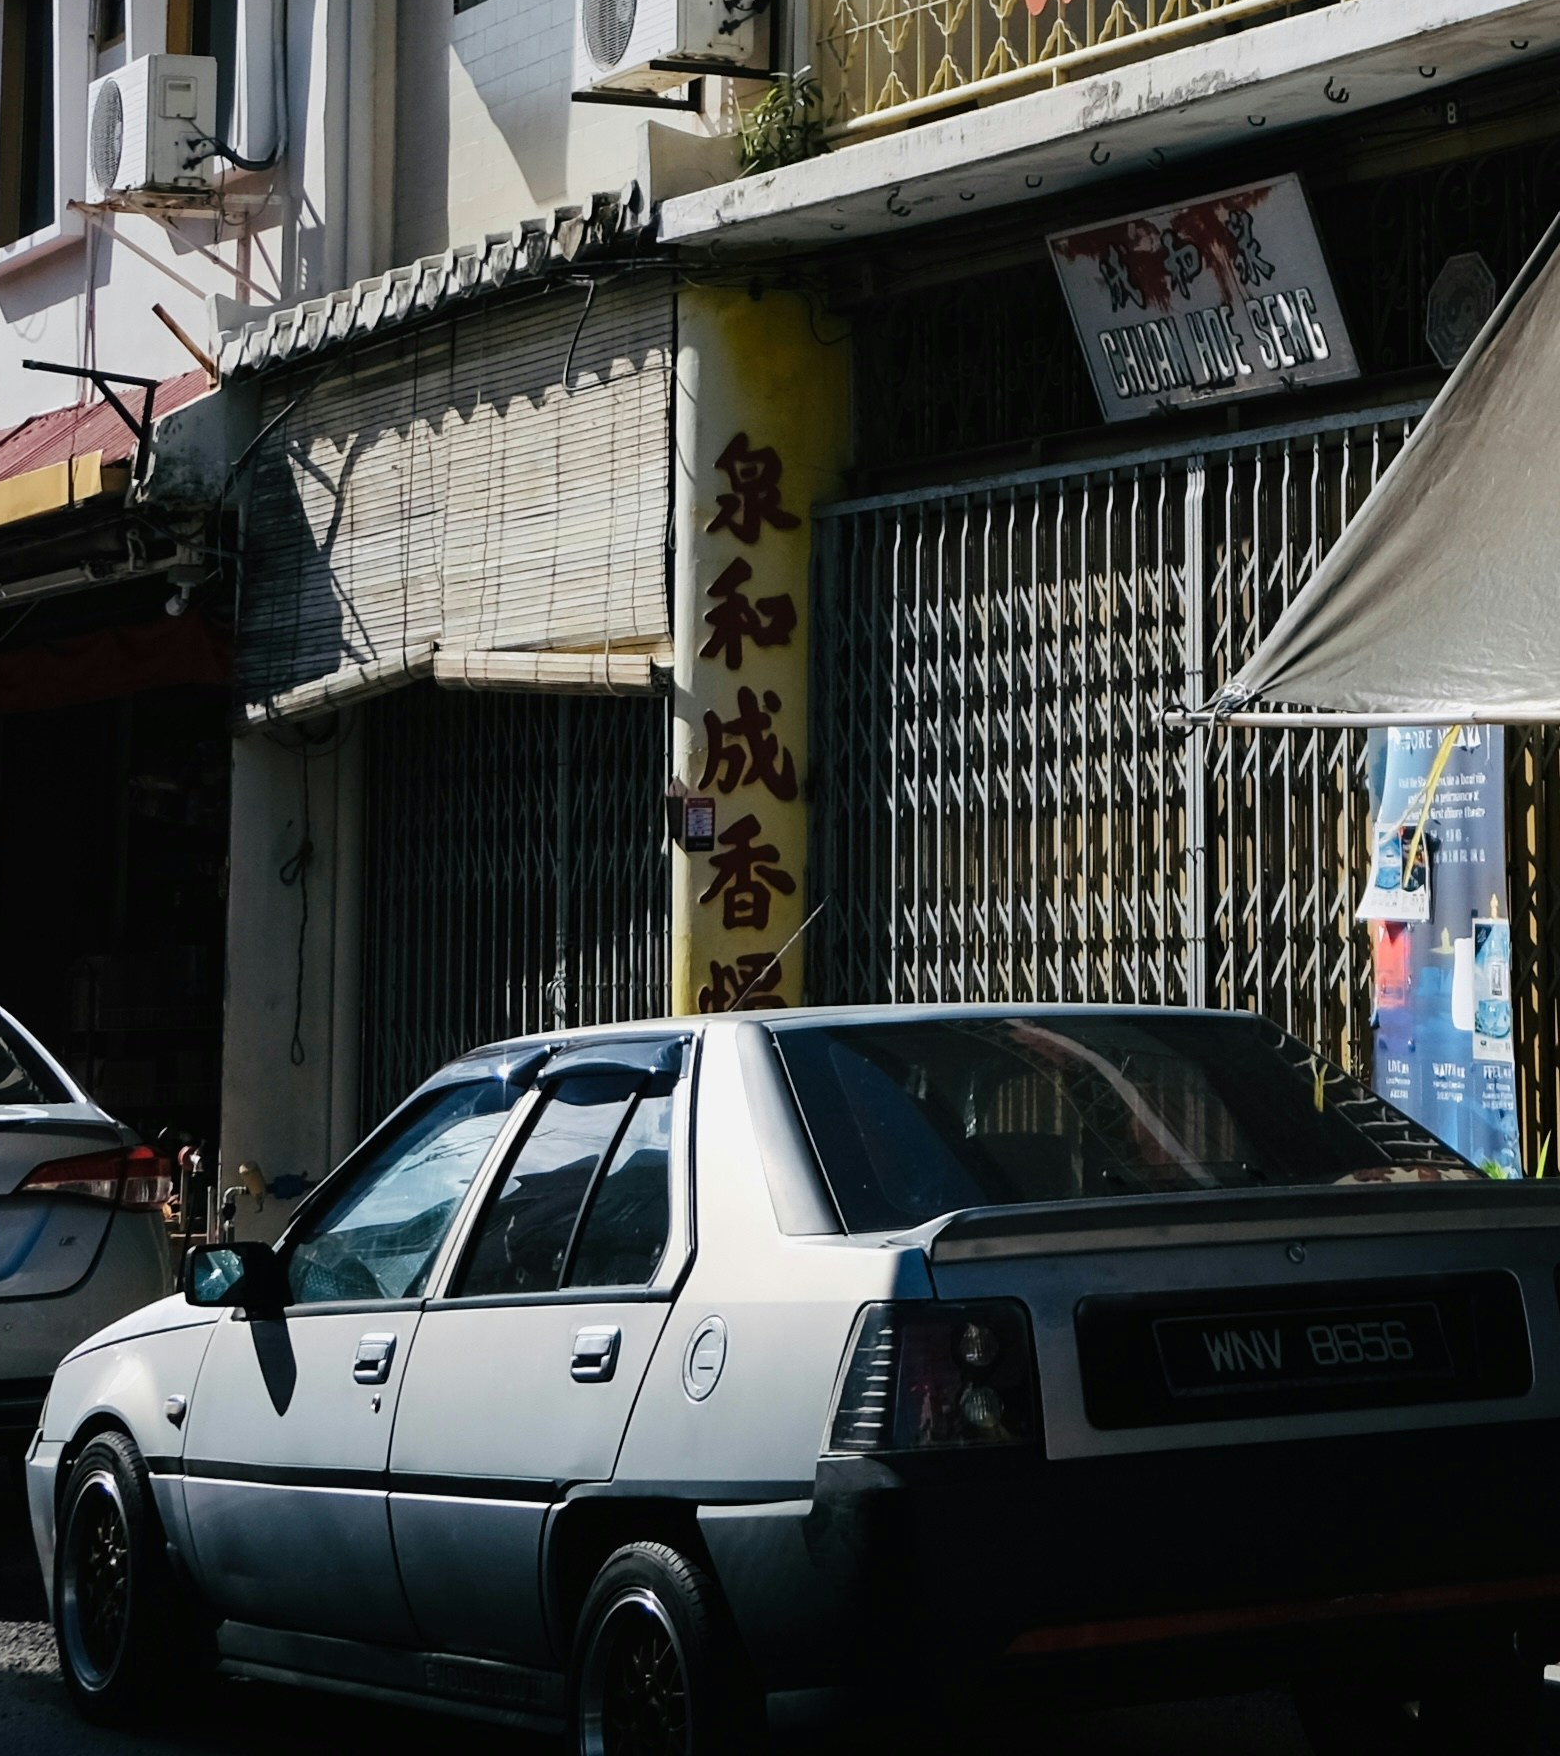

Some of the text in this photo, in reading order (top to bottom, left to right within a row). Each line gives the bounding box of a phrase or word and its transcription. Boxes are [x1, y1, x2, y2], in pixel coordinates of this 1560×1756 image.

[1097, 286, 1332, 400] CHUAN HOE SENG
[1201, 1319, 1415, 1373] WNV 8656
